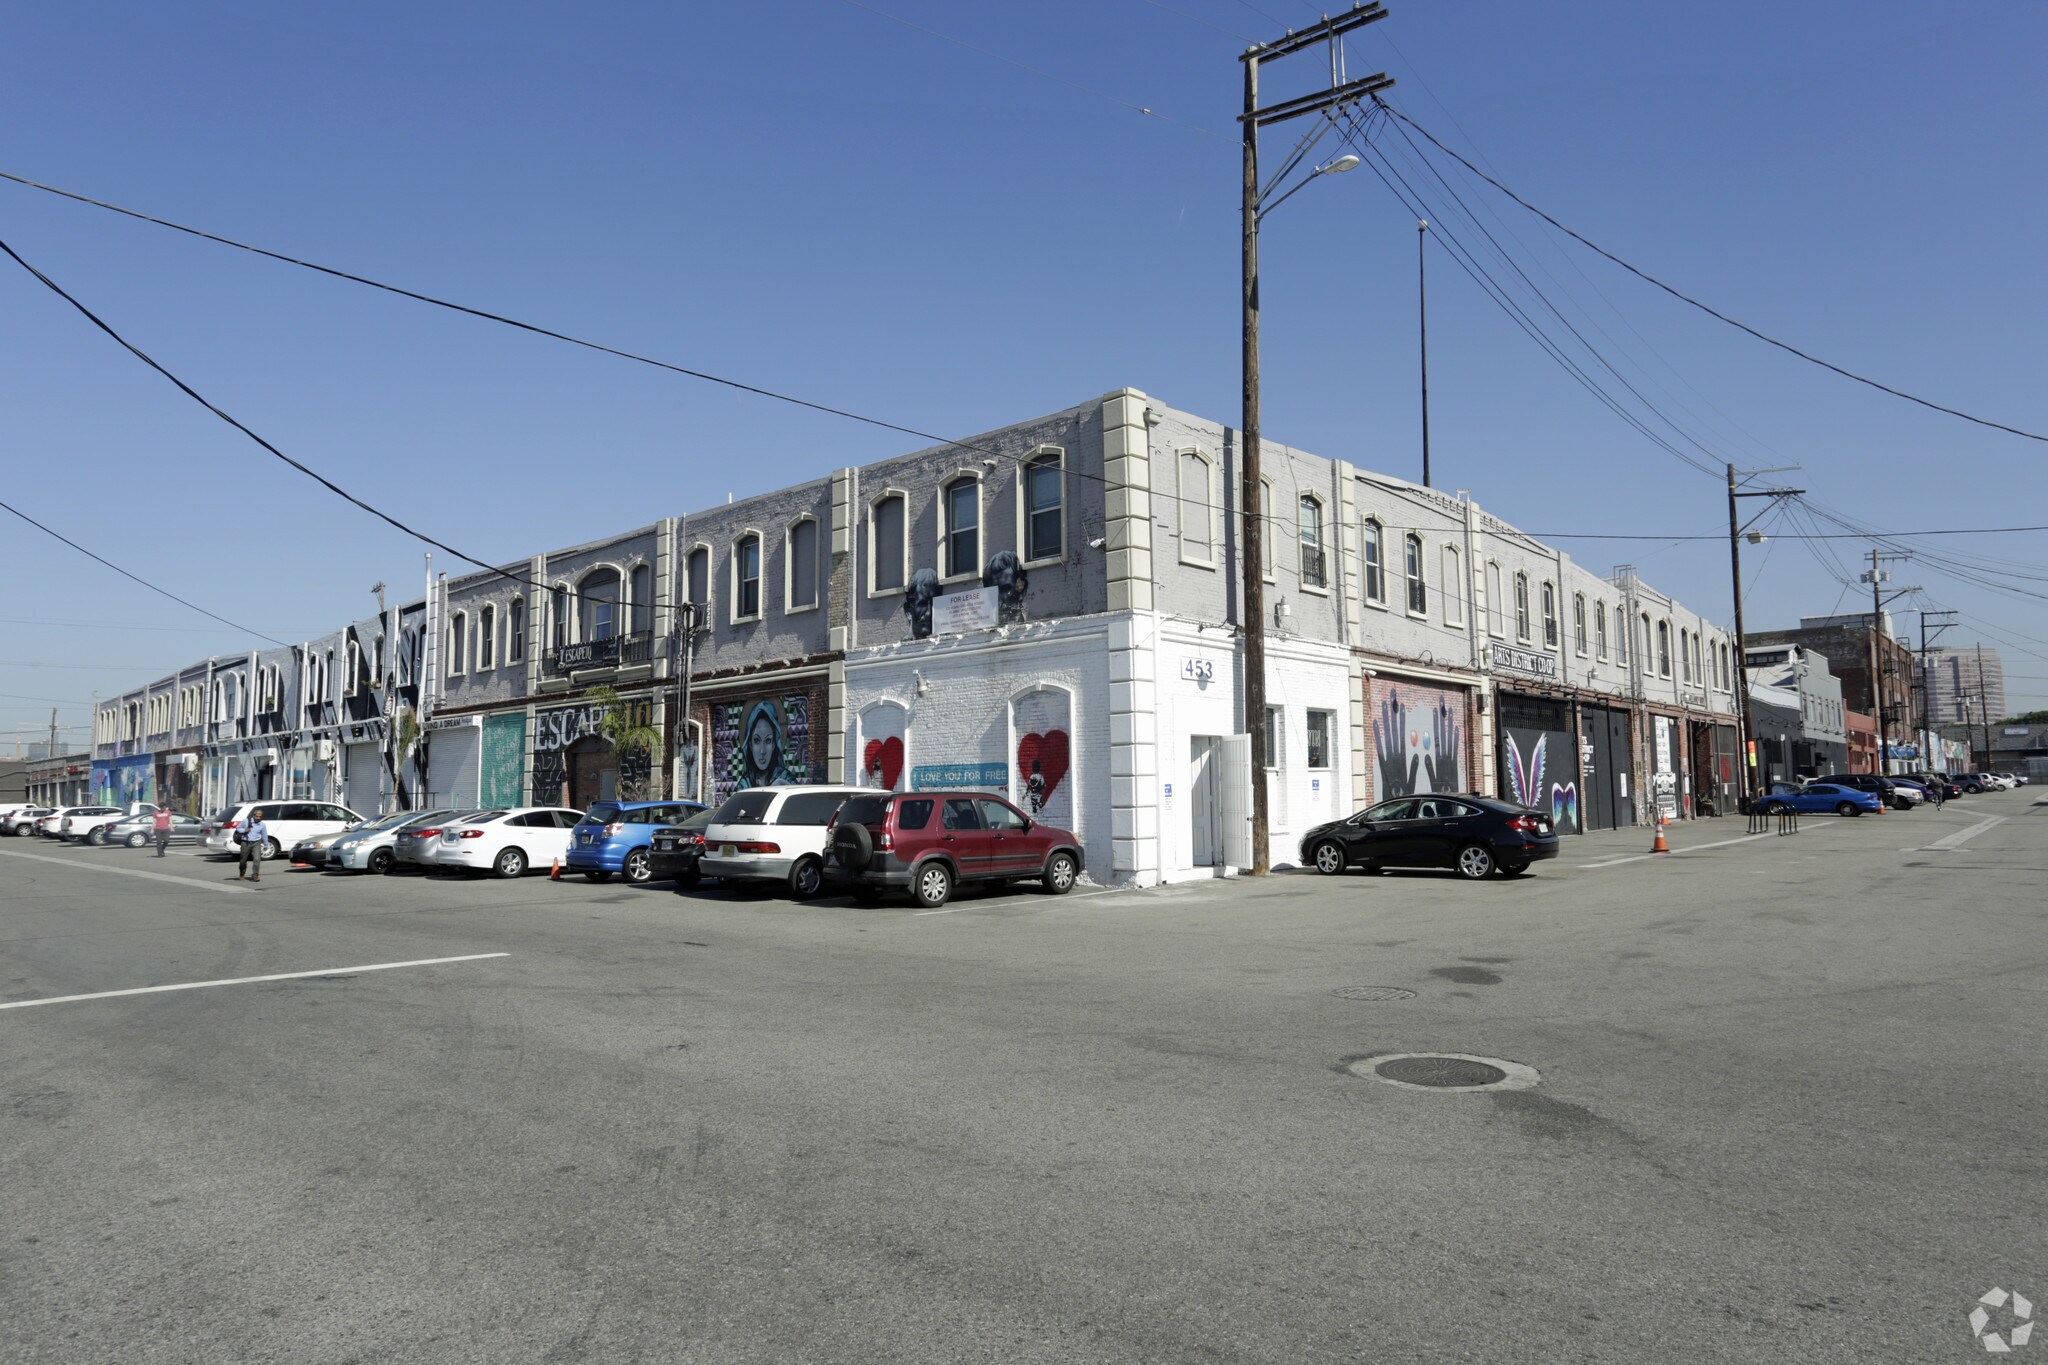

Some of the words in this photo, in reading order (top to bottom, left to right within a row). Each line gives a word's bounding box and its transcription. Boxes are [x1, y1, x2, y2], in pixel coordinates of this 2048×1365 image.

[962, 593, 980, 602] LEASE
[1494, 645, 1510, 665] ARTS
[1511, 650, 1537, 672] DISTRICT
[1185, 659, 1213, 679] 453
[439, 721, 444, 729] A
[444, 718, 461, 728] DREAM
[920, 772, 941, 782] LOVE
[944, 771, 960, 781] YOU
[964, 771, 981, 780] FOR
[985, 769, 1007, 780] FREE
